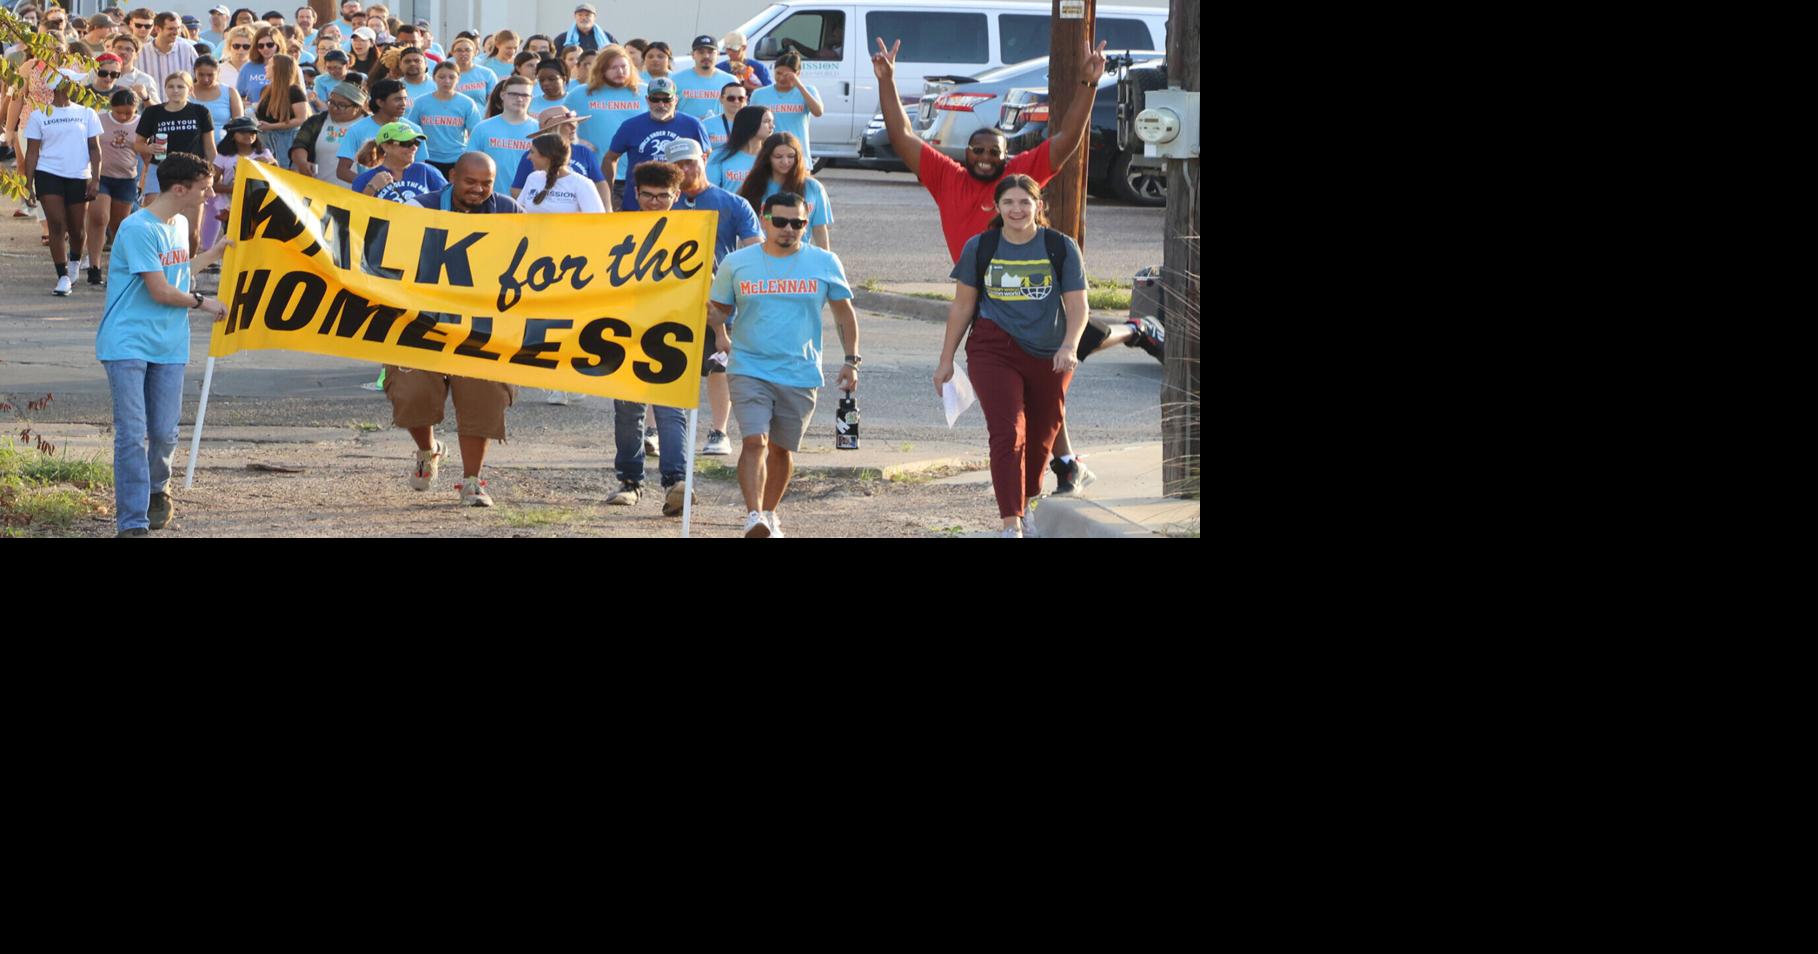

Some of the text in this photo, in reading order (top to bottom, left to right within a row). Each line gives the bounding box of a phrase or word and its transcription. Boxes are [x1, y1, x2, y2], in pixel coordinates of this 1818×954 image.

[682, 89, 720, 99] McLENNA
[589, 101, 640, 110] McLENNAN
[770, 104, 804, 112] LENNAN
[421, 115, 464, 126] McLENNAN
[490, 137, 531, 150] McLENNA
[545, 189, 577, 199] ISSION
[240, 178, 703, 312] WALK for the
[740, 280, 817, 295] McLENNAN
[224, 269, 694, 384] HOMELESS
